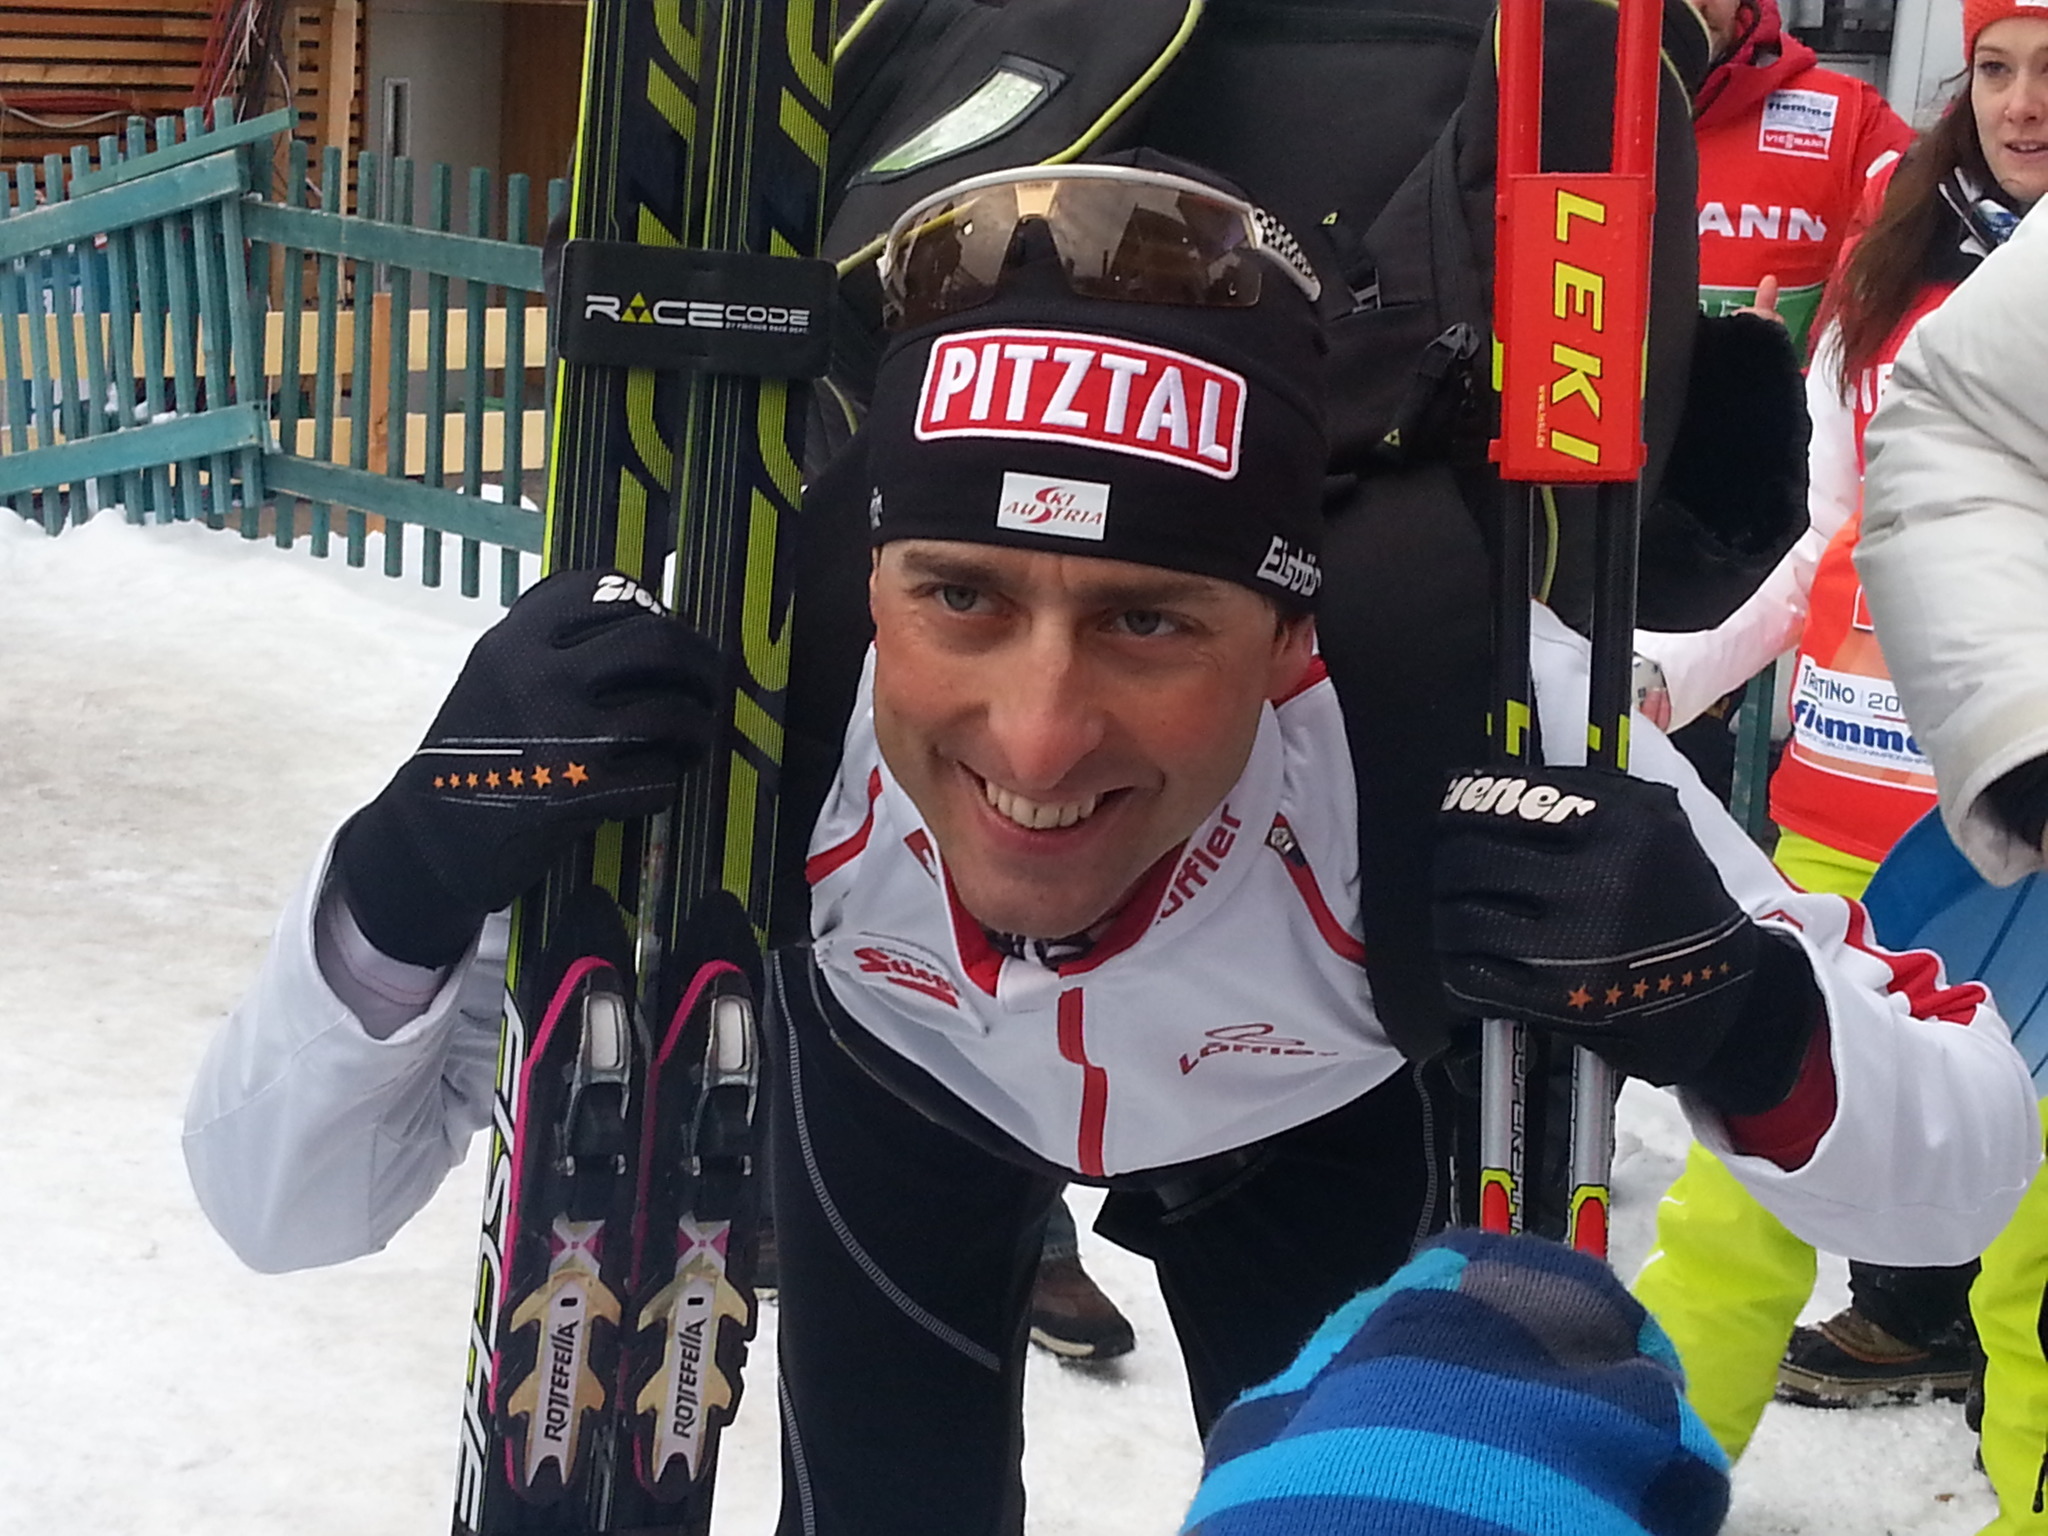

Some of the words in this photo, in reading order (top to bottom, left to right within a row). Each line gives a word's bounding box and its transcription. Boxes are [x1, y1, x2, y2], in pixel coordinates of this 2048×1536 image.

[1551, 189, 1605, 466] LEKI
[930, 343, 1229, 461] PITZTAL
[1004, 501, 1103, 525] AUSTRIA
[1803, 664, 1855, 704] TRTINO
[1156, 802, 1242, 922] ffler
